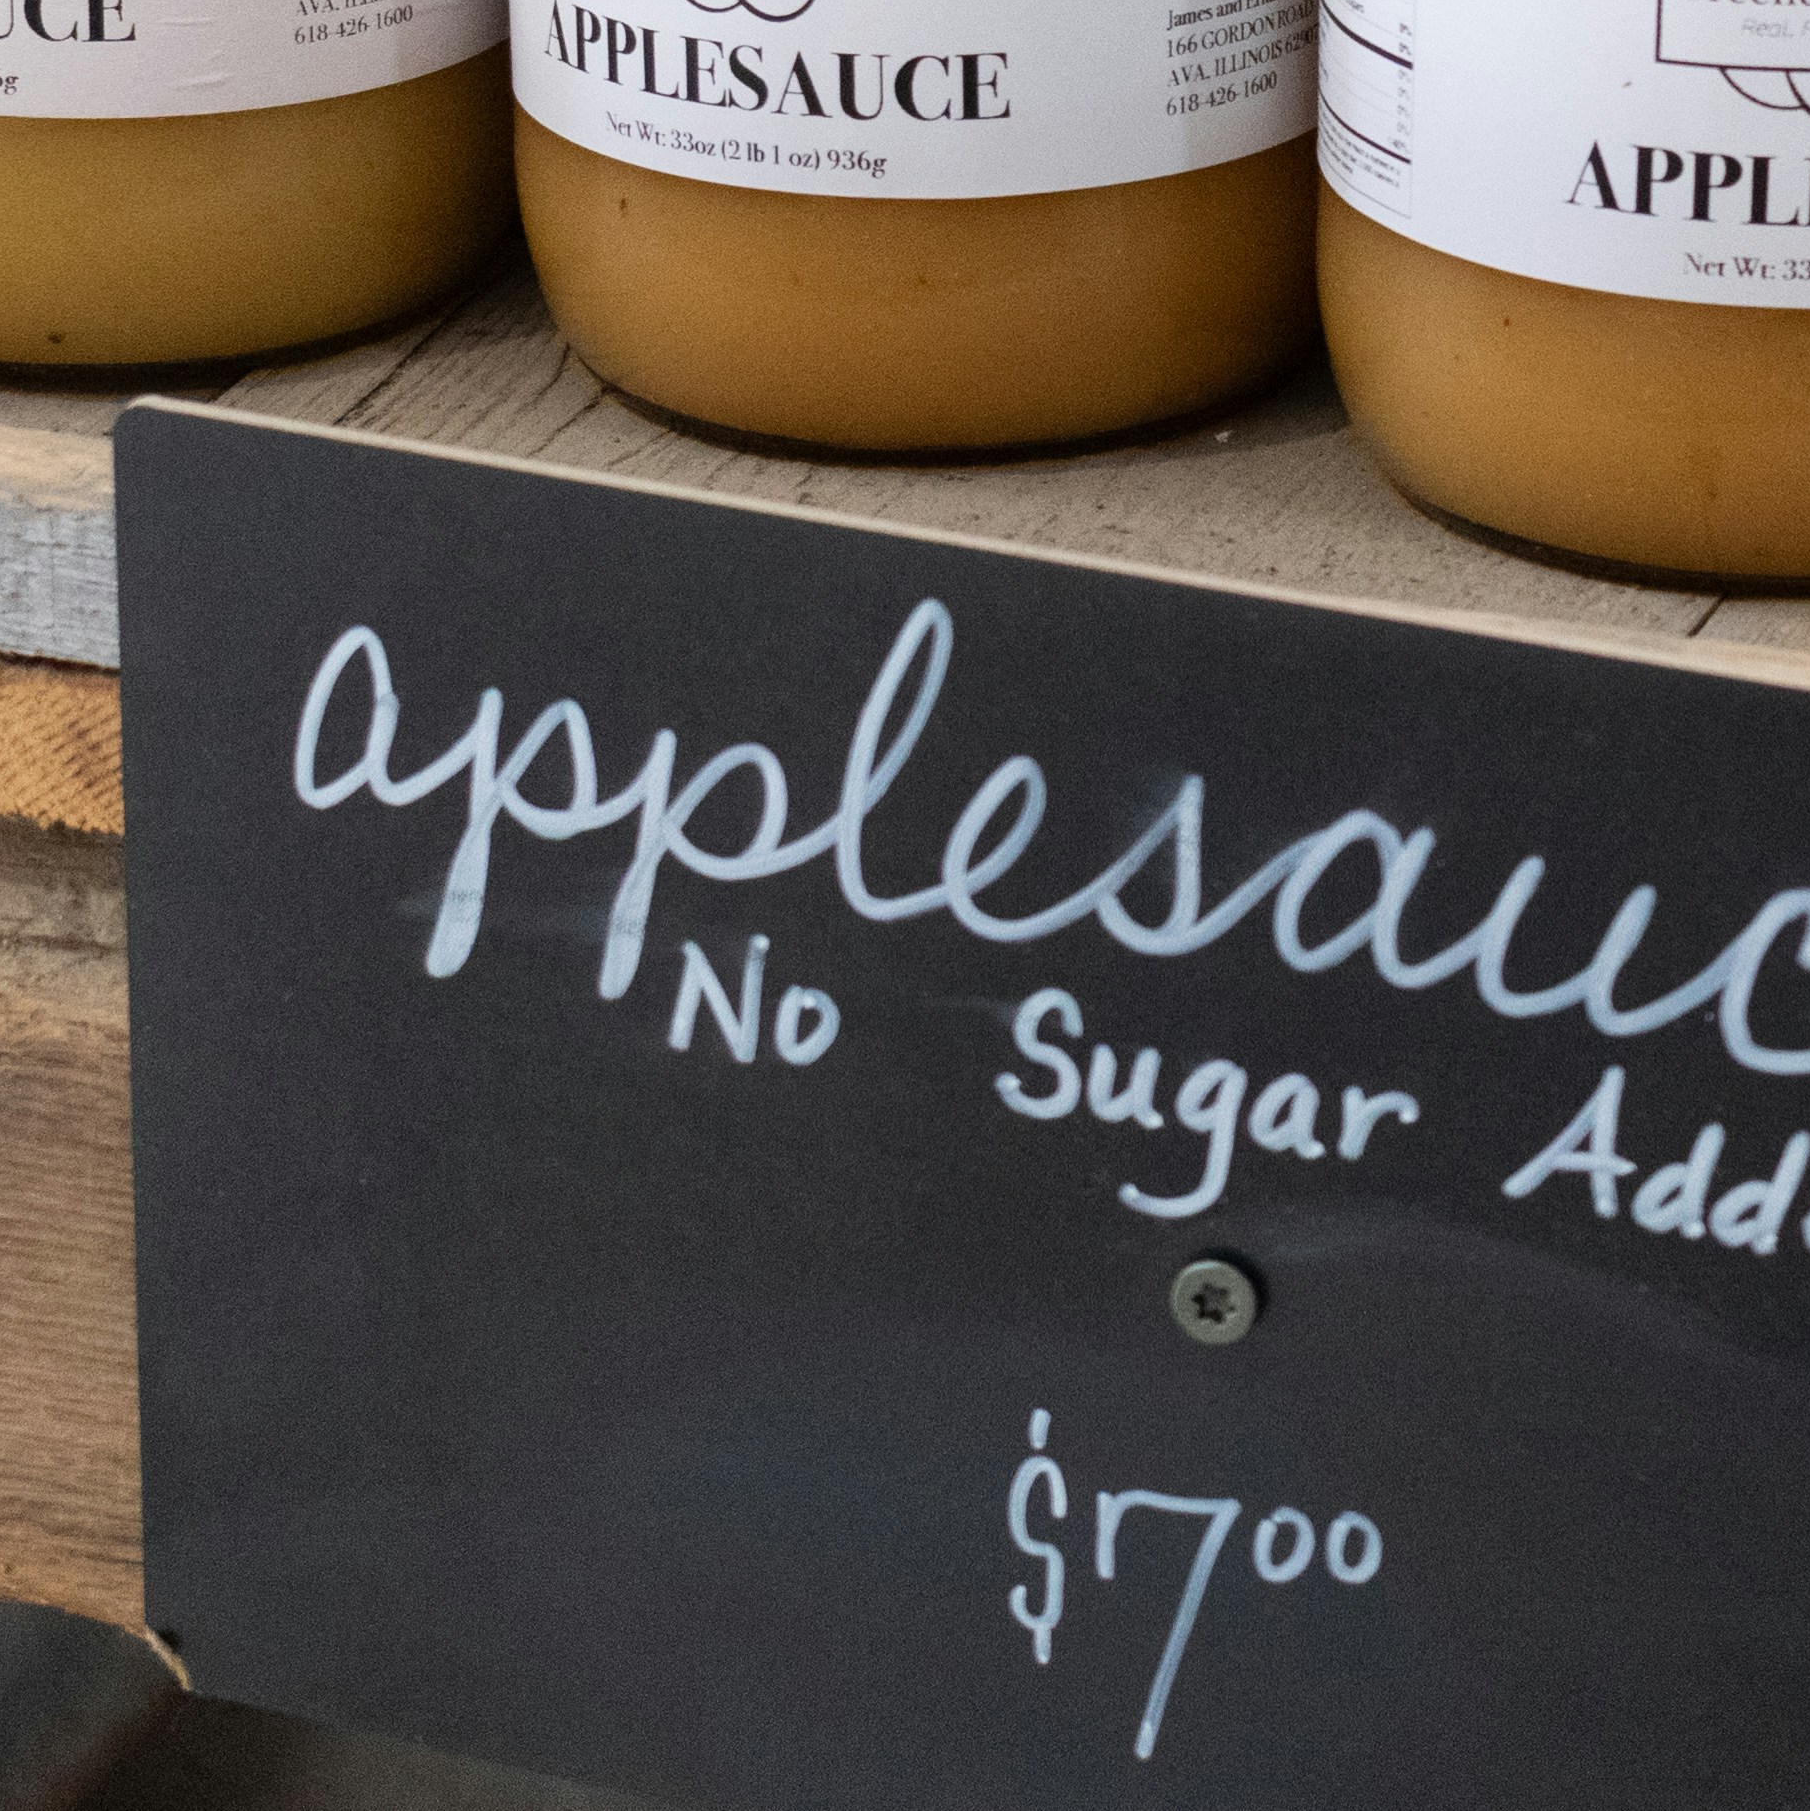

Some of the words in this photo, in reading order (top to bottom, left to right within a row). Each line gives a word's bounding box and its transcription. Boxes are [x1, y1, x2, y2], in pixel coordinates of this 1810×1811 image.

[1166, 7, 1214, 32] James
[1166, 33, 1199, 58] 166
[1200, 12, 1275, 53] GORDON
[1214, 39, 1284, 78] ILLINOIS
[605, 110, 634, 140] Net
[634, 118, 668, 147] Wt:
[669, 128, 718, 158] 33oz
[720, 137, 743, 163] (2
[745, 141, 767, 164] lb
[787, 147, 823, 173] oz)
[826, 147, 889, 179] 936g
[1683, 250, 1728, 279] Net
[668, 933, 841, 1065] No
[996, 987, 1420, 1219] Sugar
